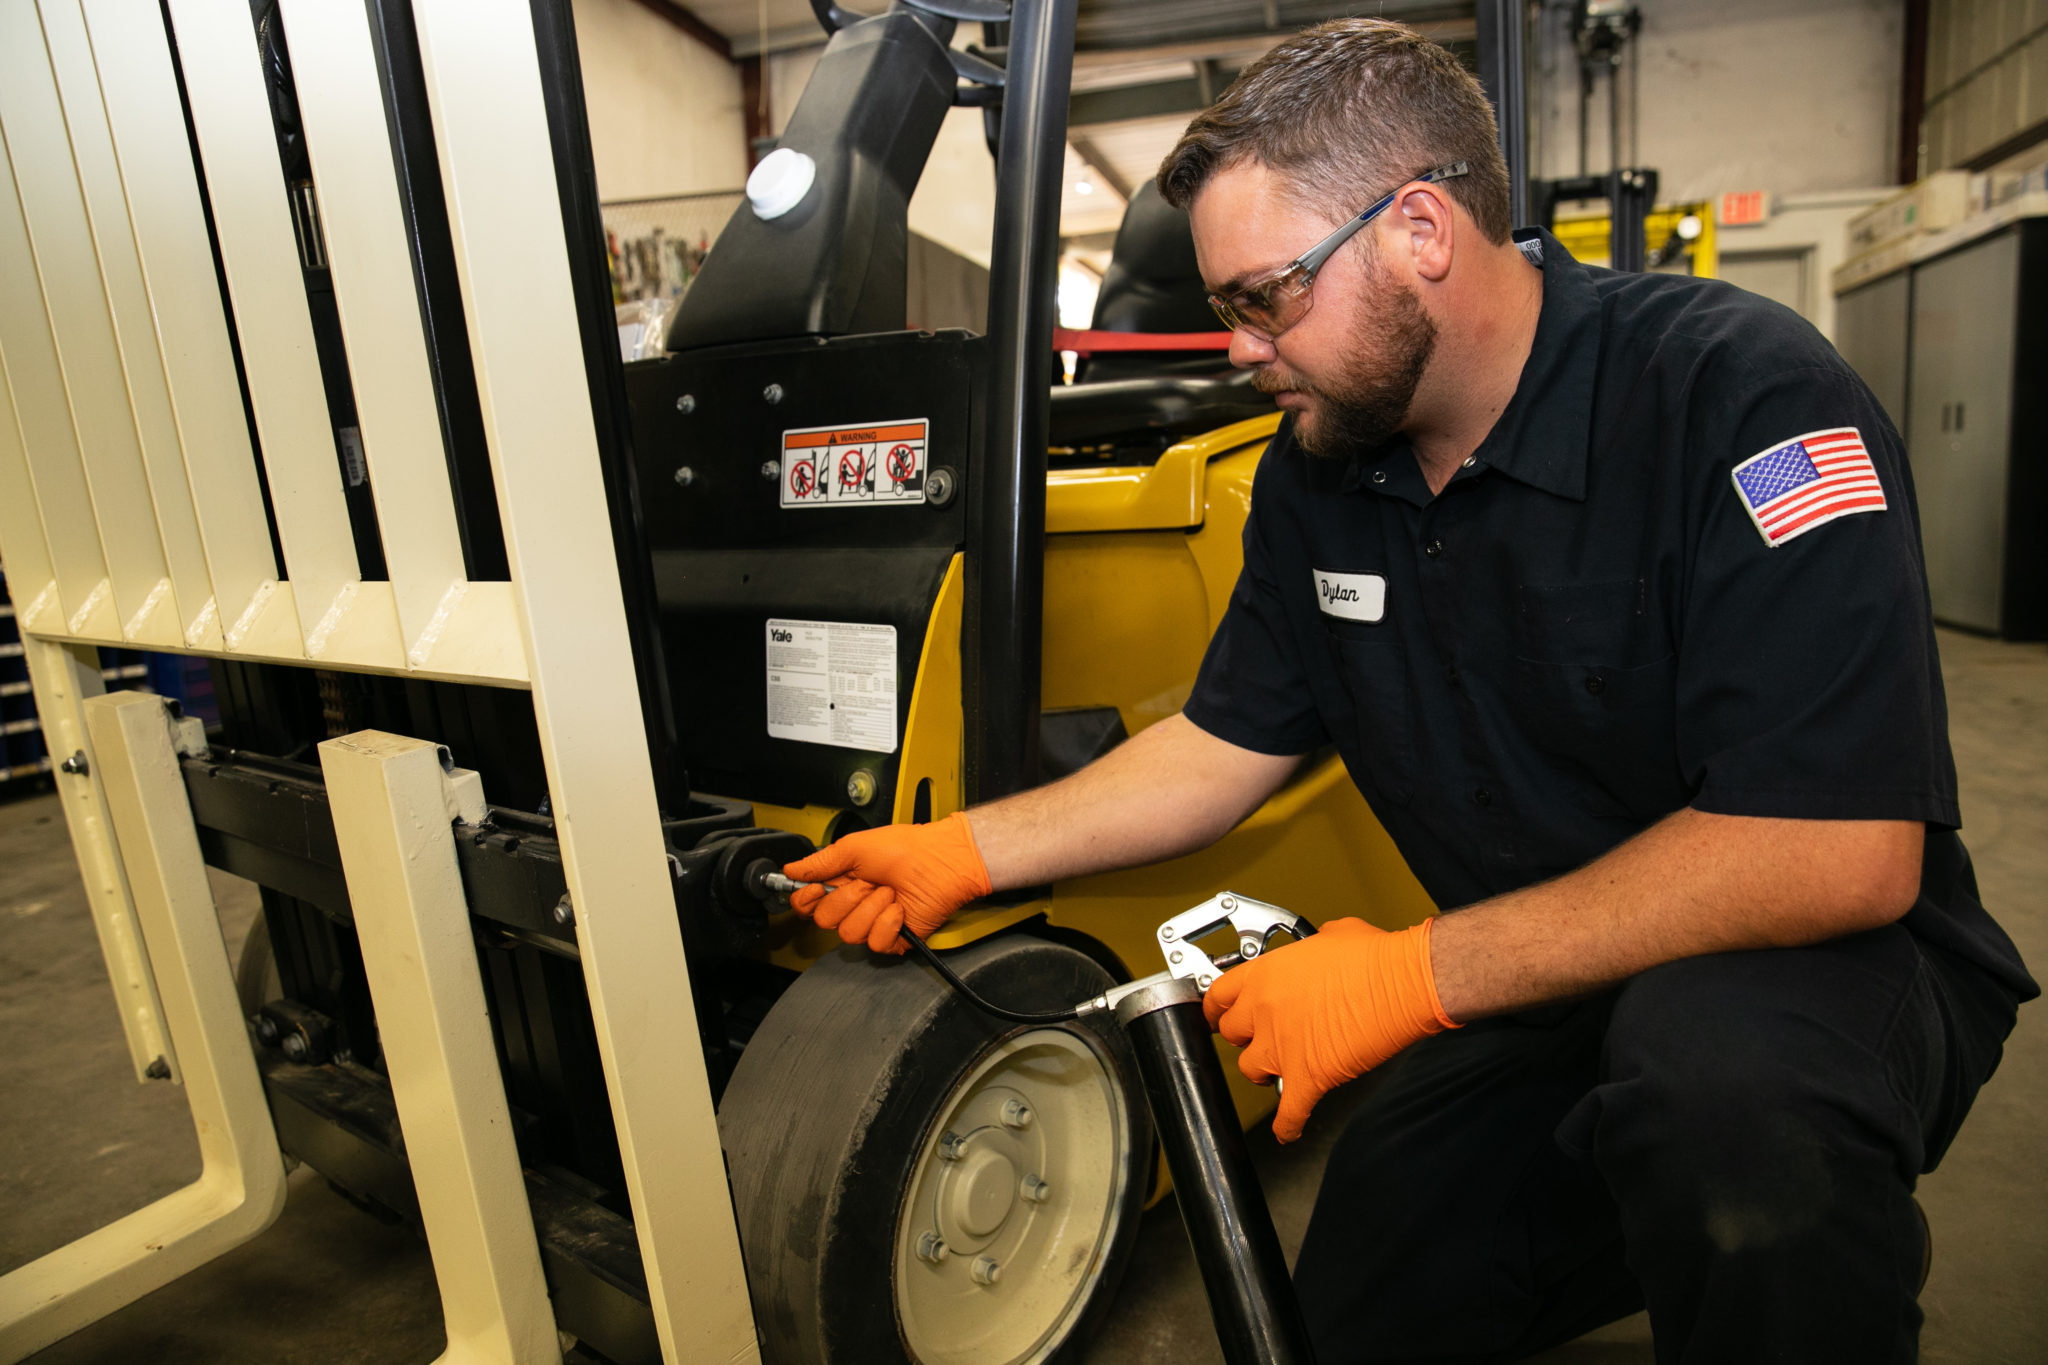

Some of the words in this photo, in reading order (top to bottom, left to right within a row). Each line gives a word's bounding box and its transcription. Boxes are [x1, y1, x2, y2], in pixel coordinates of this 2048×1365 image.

[840, 431, 877, 441] WARNING
[1321, 579, 1360, 605] Dylan
[771, 629, 793, 643] Yale
